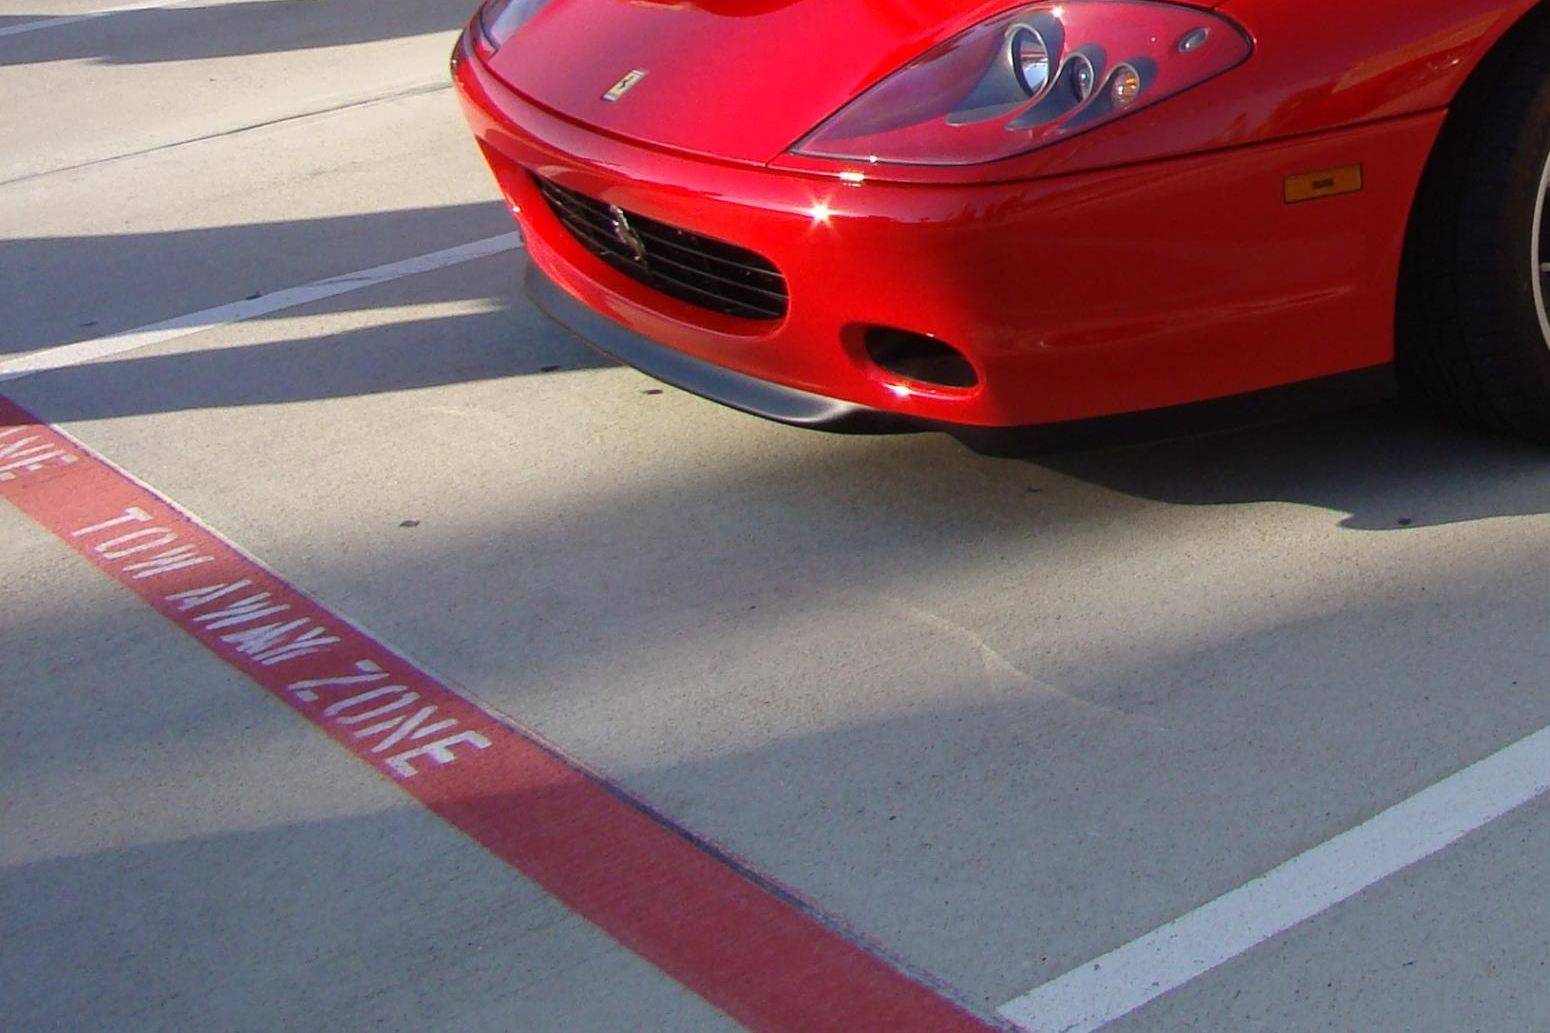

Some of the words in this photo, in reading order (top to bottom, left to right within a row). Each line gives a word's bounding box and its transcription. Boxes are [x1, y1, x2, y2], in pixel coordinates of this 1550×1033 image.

[72, 507, 214, 579] TOW
[165, 579, 341, 665] AWAY
[288, 658, 492, 778] ZONE
